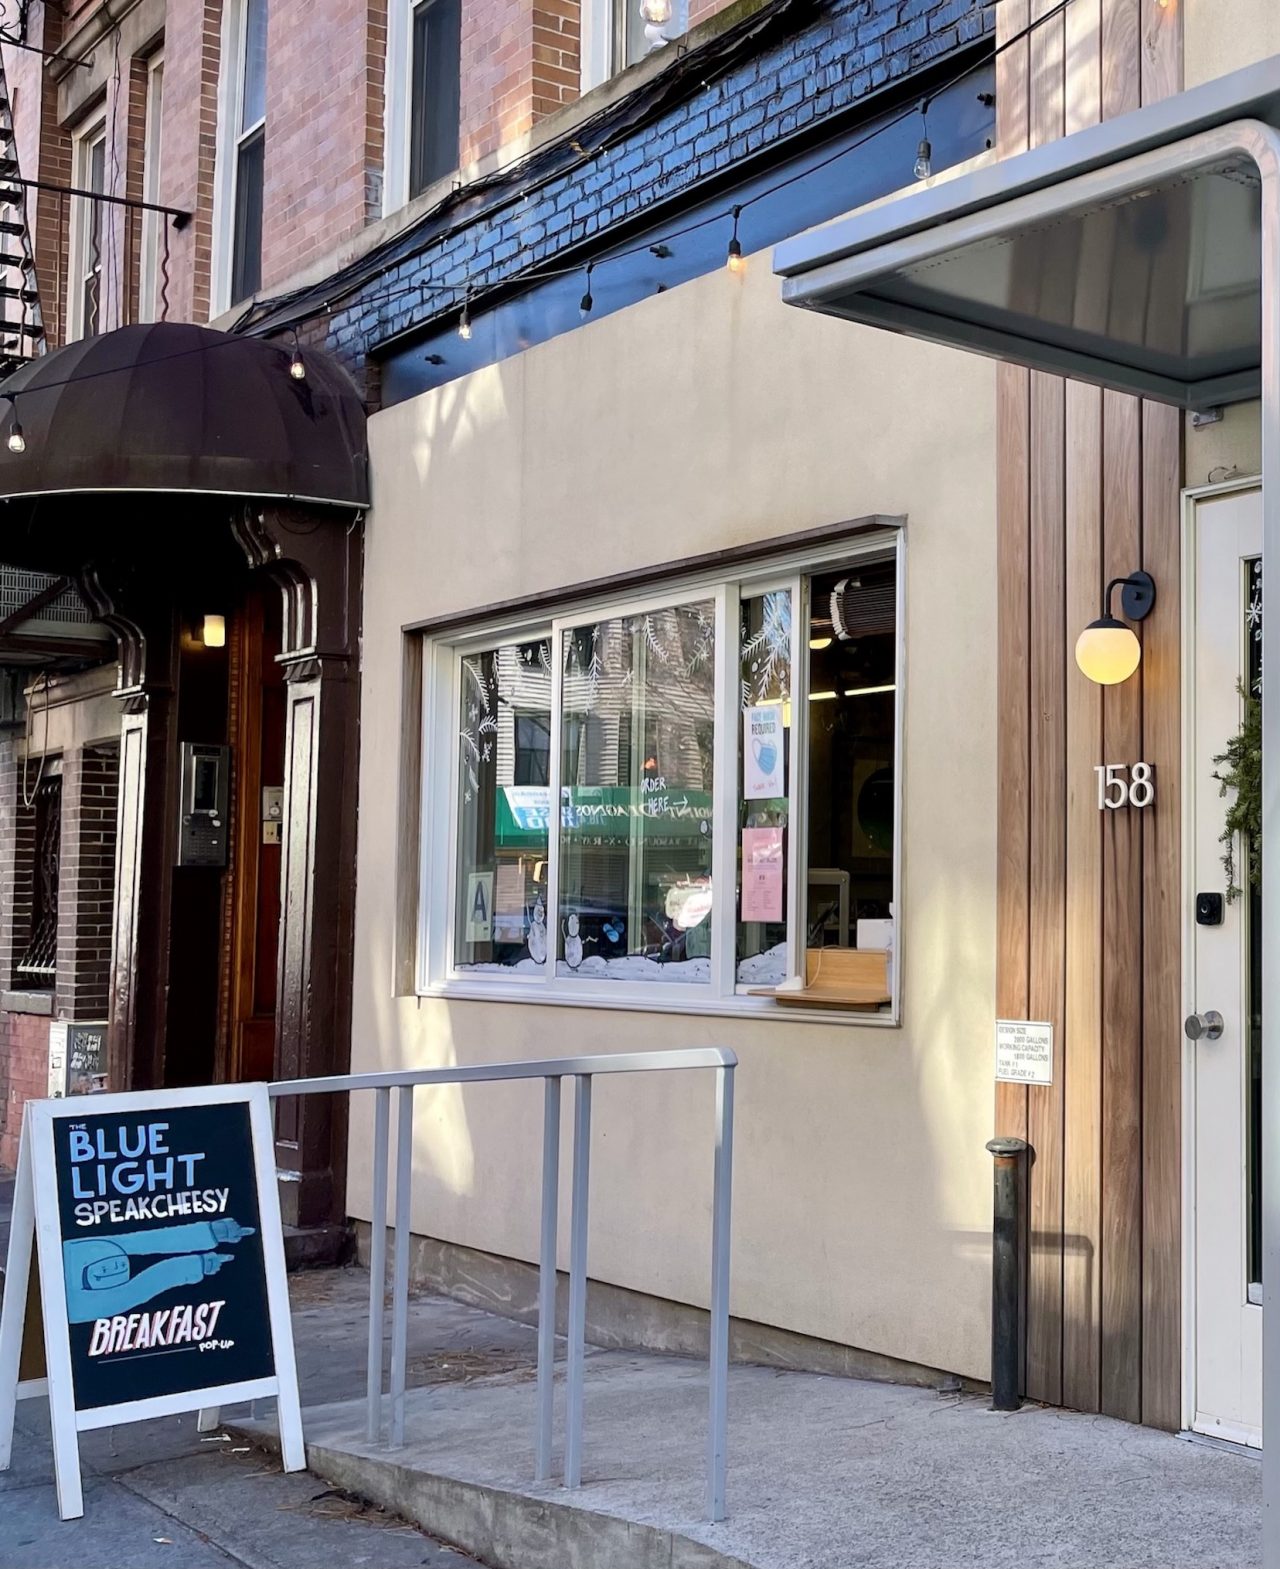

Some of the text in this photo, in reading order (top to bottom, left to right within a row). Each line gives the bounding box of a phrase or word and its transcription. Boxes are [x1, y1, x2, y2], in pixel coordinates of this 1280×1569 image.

[640, 776, 667, 794] ORDER
[1093, 762, 1155, 811] 158
[648, 796, 670, 815] HERE
[470, 881, 487, 922] A
[69, 1123, 87, 1131] THE
[69, 1123, 170, 1163] BLUE
[71, 1153, 206, 1199] LIGHT
[74, 1187, 229, 1226] SPEAKCHEESY
[88, 1300, 226, 1357] BREAKFAST
[199, 1339, 235, 1352] POP-UP
